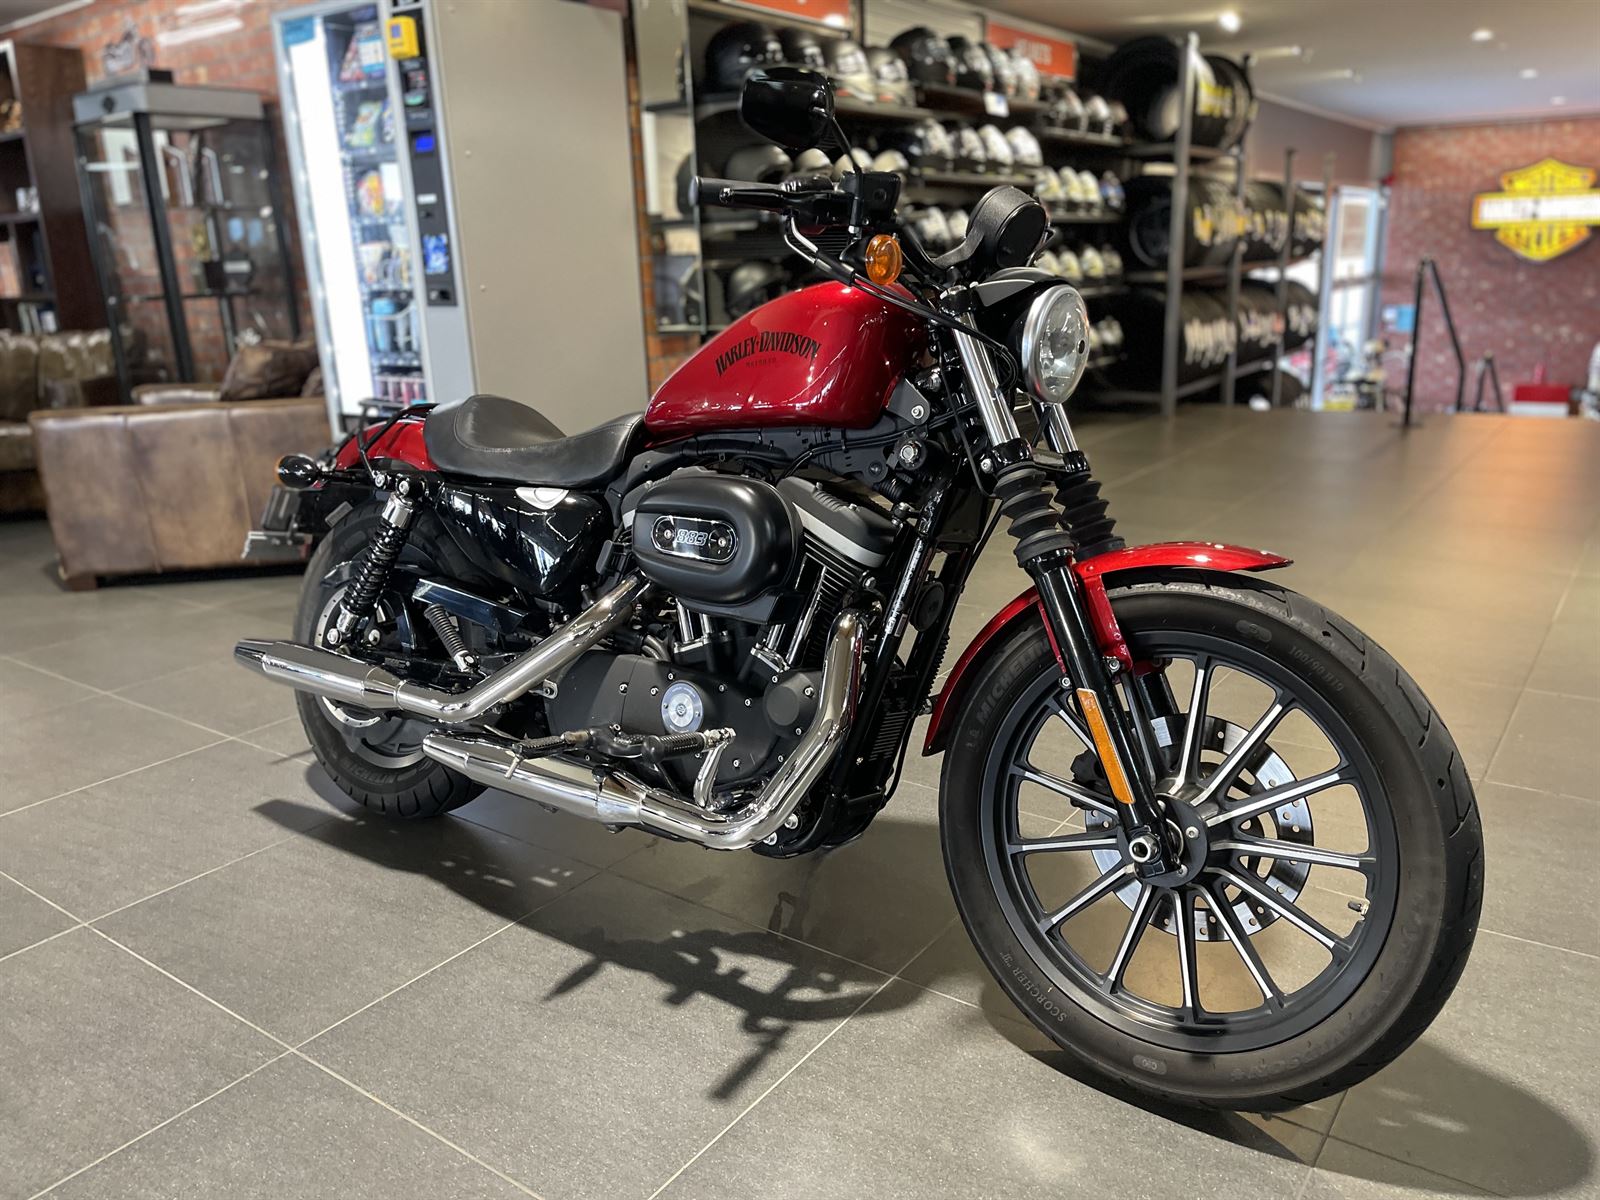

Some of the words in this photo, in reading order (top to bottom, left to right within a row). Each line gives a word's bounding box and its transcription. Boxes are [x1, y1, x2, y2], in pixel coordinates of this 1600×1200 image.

[715, 330, 822, 376] HARLEY-DAVIDSON
[676, 528, 708, 546] 883
[1012, 967, 1067, 1022] SCORCHER
